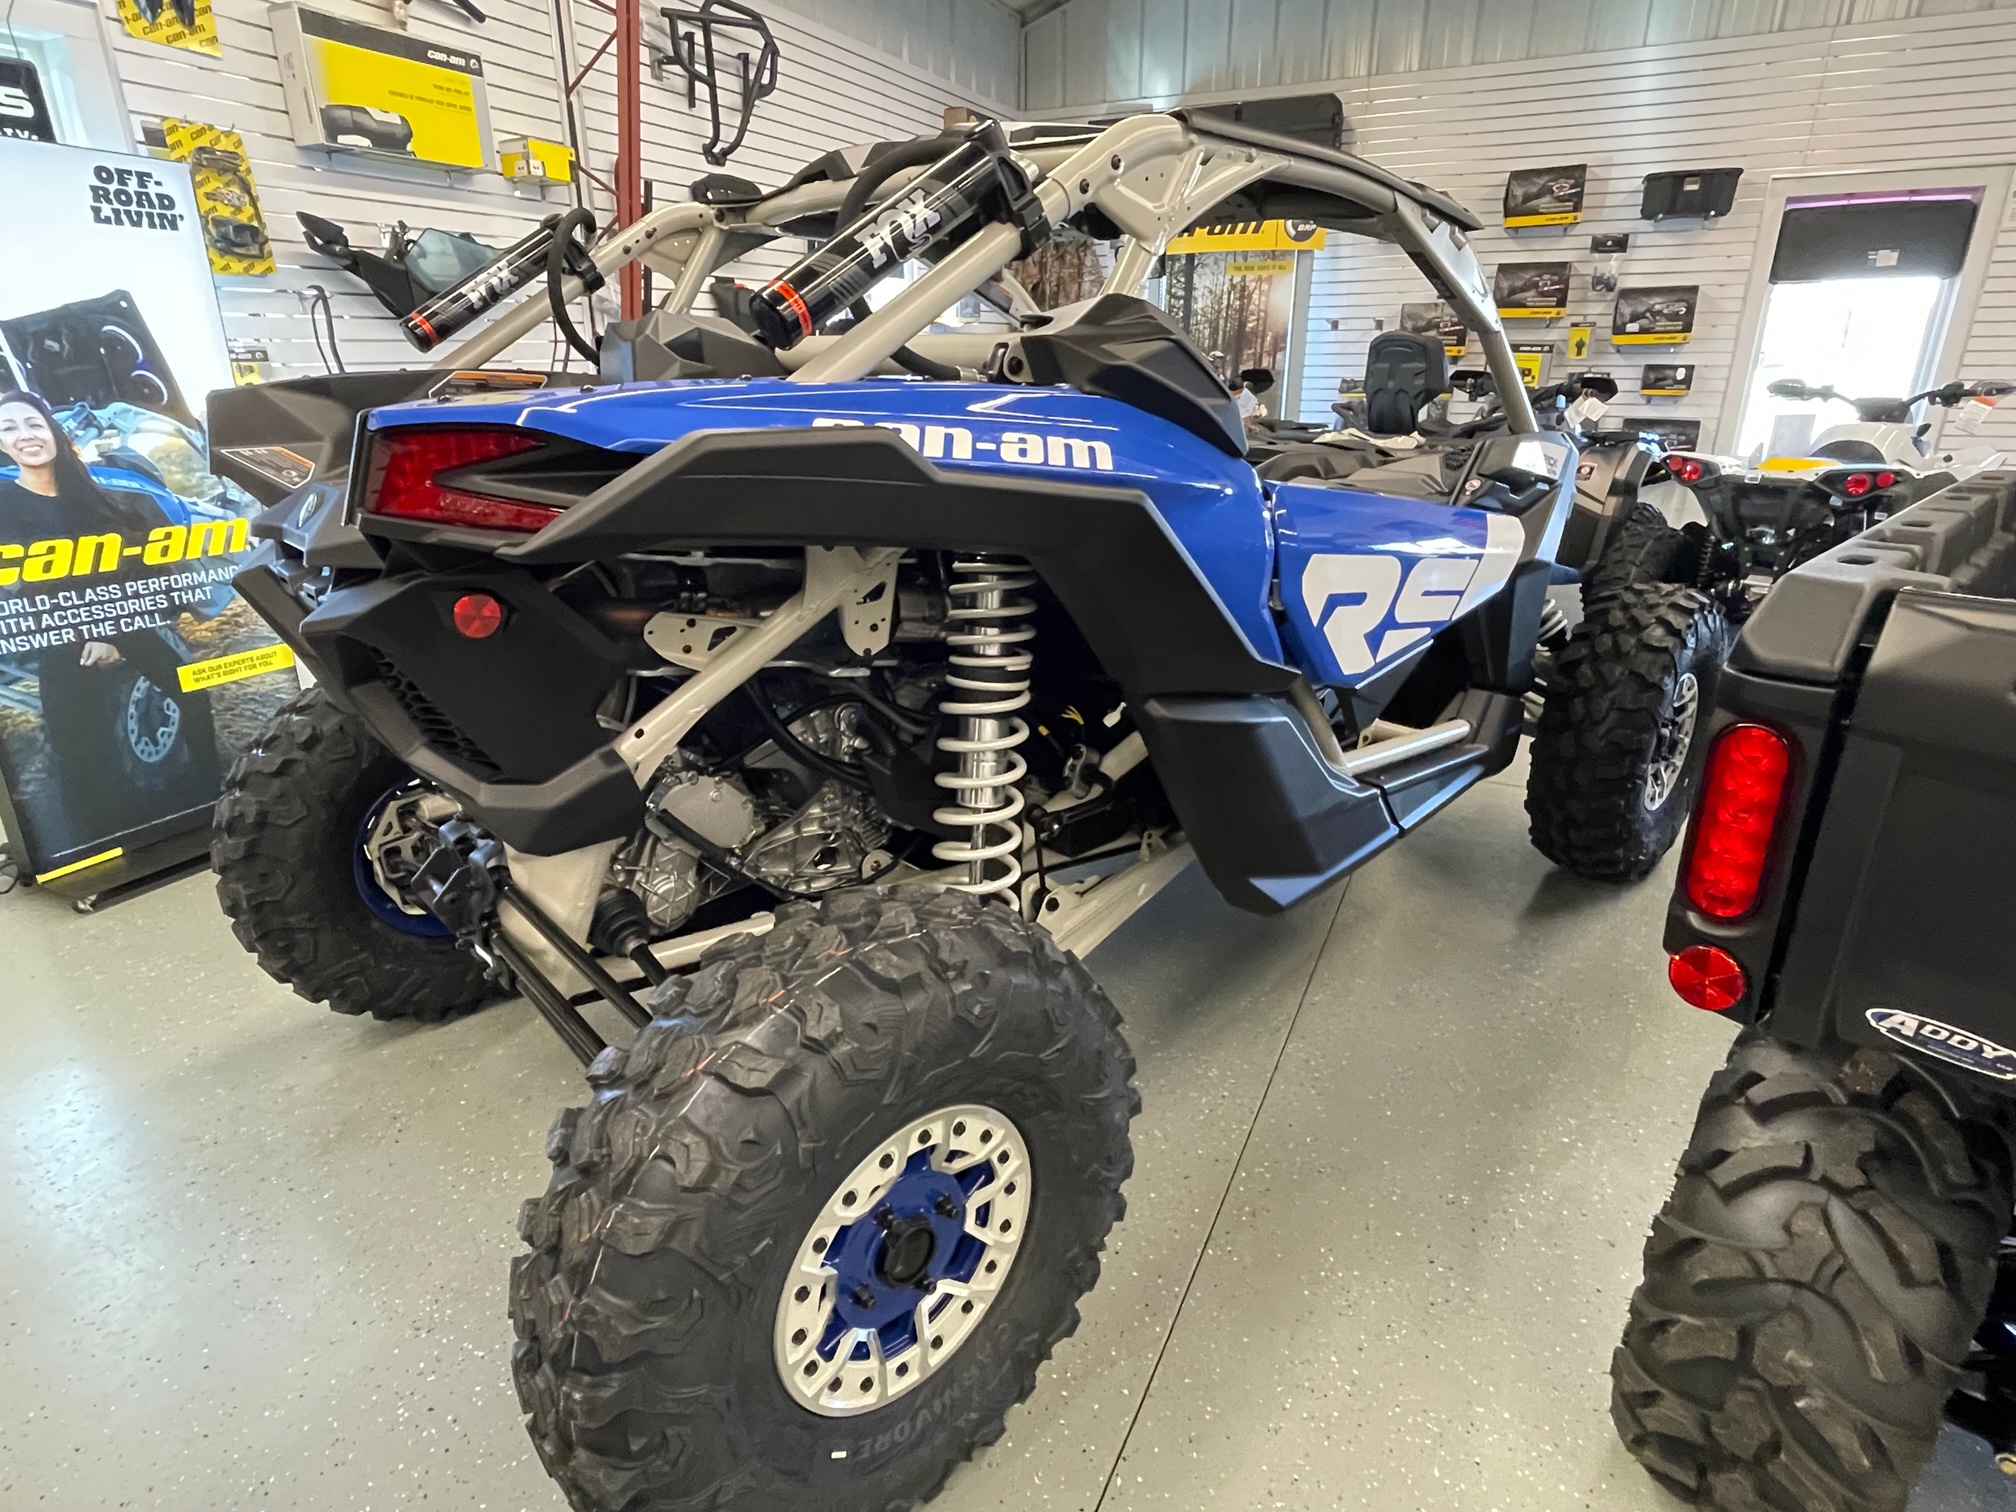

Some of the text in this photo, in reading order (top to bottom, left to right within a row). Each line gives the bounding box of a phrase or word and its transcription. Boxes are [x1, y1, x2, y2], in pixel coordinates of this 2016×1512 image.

[427, 49, 466, 67] can-am
[93, 164, 164, 190] OFF-
[88, 184, 176, 211] ROAD
[90, 204, 185, 232] LIVIN'
[853, 188, 943, 269] FOX
[1297, 222, 1317, 233] BRP
[811, 417, 1114, 471] an-am
[0, 564, 242, 617] ORLD-CLASS PERFORMANC
[0, 586, 213, 635] ITH ACCESSORIES THAT
[0, 612, 171, 656] NSWER THE CALL.
[192, 651, 277, 676] ASK OUR EXPERTS ABOUT
[192, 671, 222, 683] WHAT'S
[222, 666, 243, 677] RIGHT
[244, 663, 258, 672] FOR
[1877, 1013, 2012, 1059] ADDY
